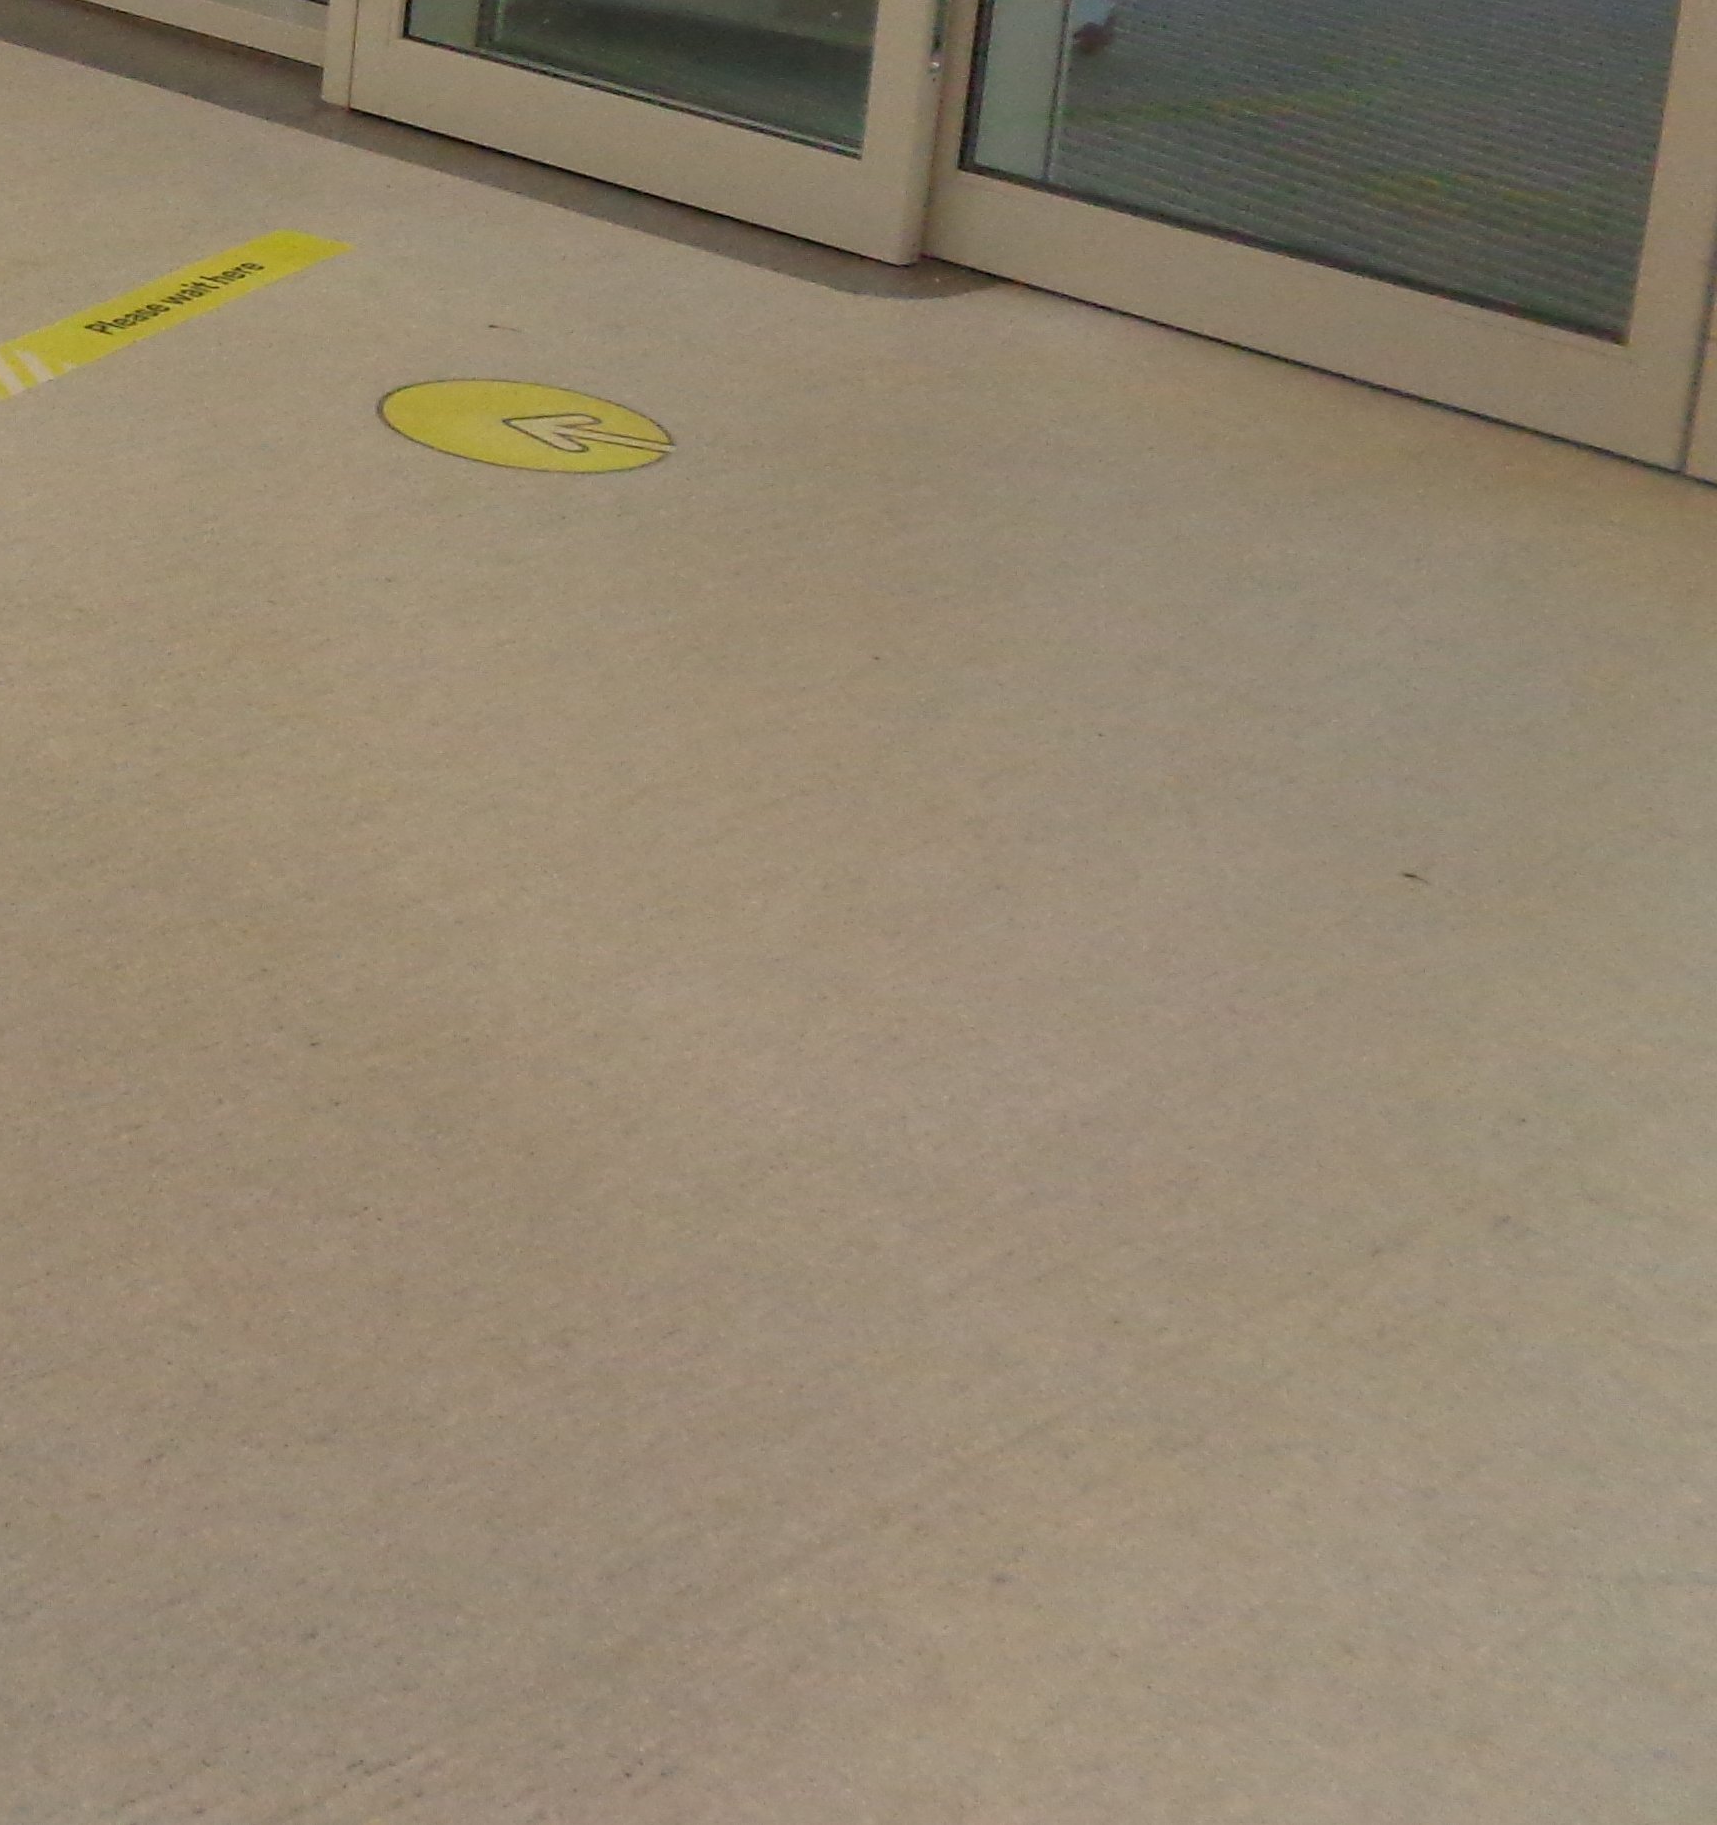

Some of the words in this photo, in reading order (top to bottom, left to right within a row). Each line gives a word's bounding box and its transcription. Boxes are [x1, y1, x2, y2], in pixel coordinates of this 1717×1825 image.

[84, 303, 171, 336] Please
[161, 275, 220, 306] wait
[215, 262, 266, 286] here
